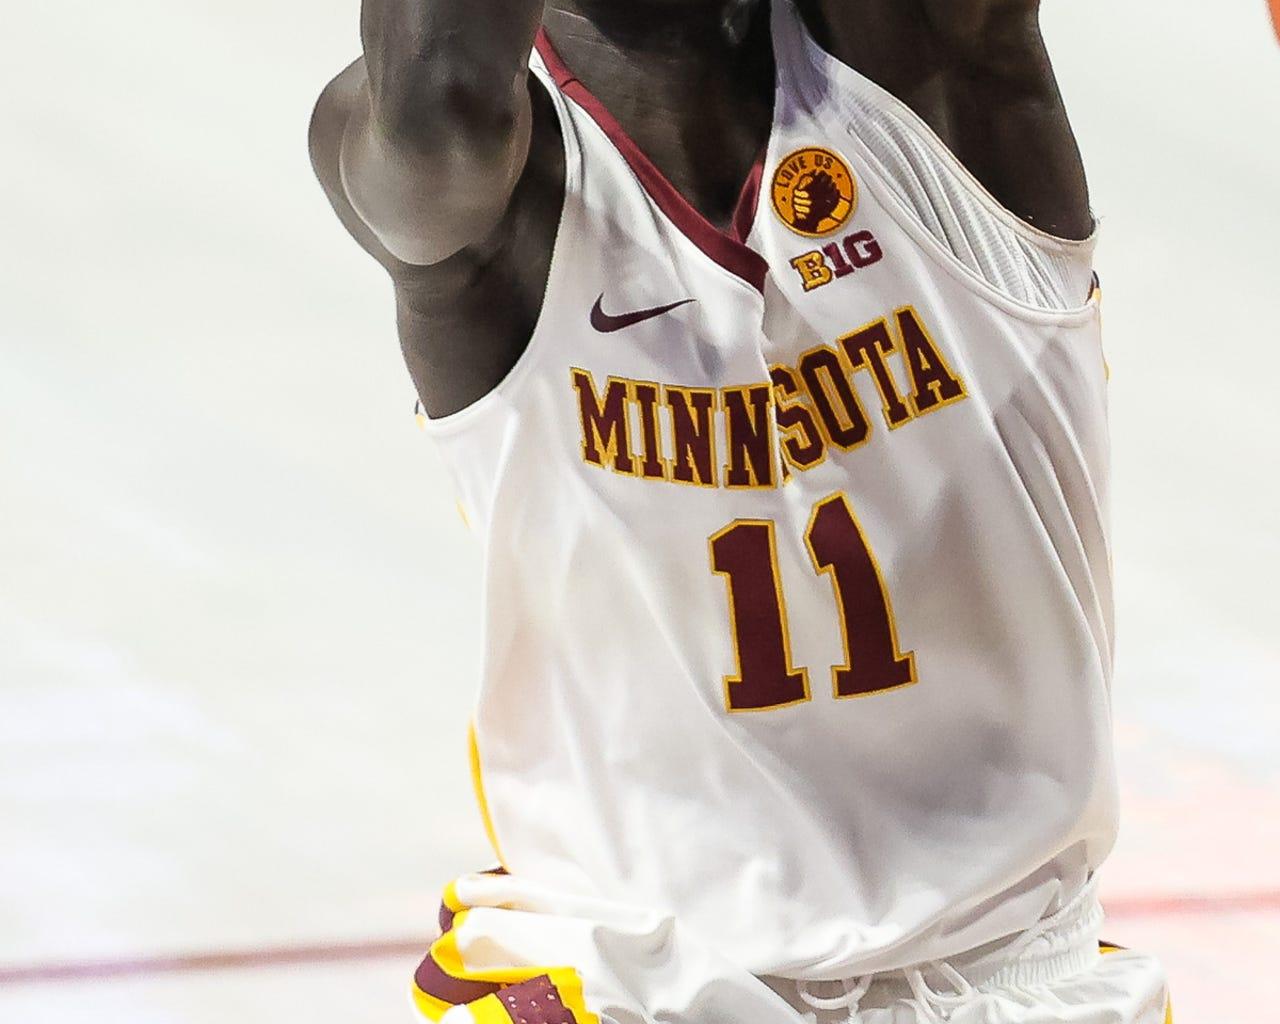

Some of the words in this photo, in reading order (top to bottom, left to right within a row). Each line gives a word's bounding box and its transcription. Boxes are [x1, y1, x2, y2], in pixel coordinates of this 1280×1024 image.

[776, 156, 807, 188] LOVE
[814, 154, 834, 170] US
[569, 304, 971, 490] MINNSOTA
[708, 490, 919, 713] 11
